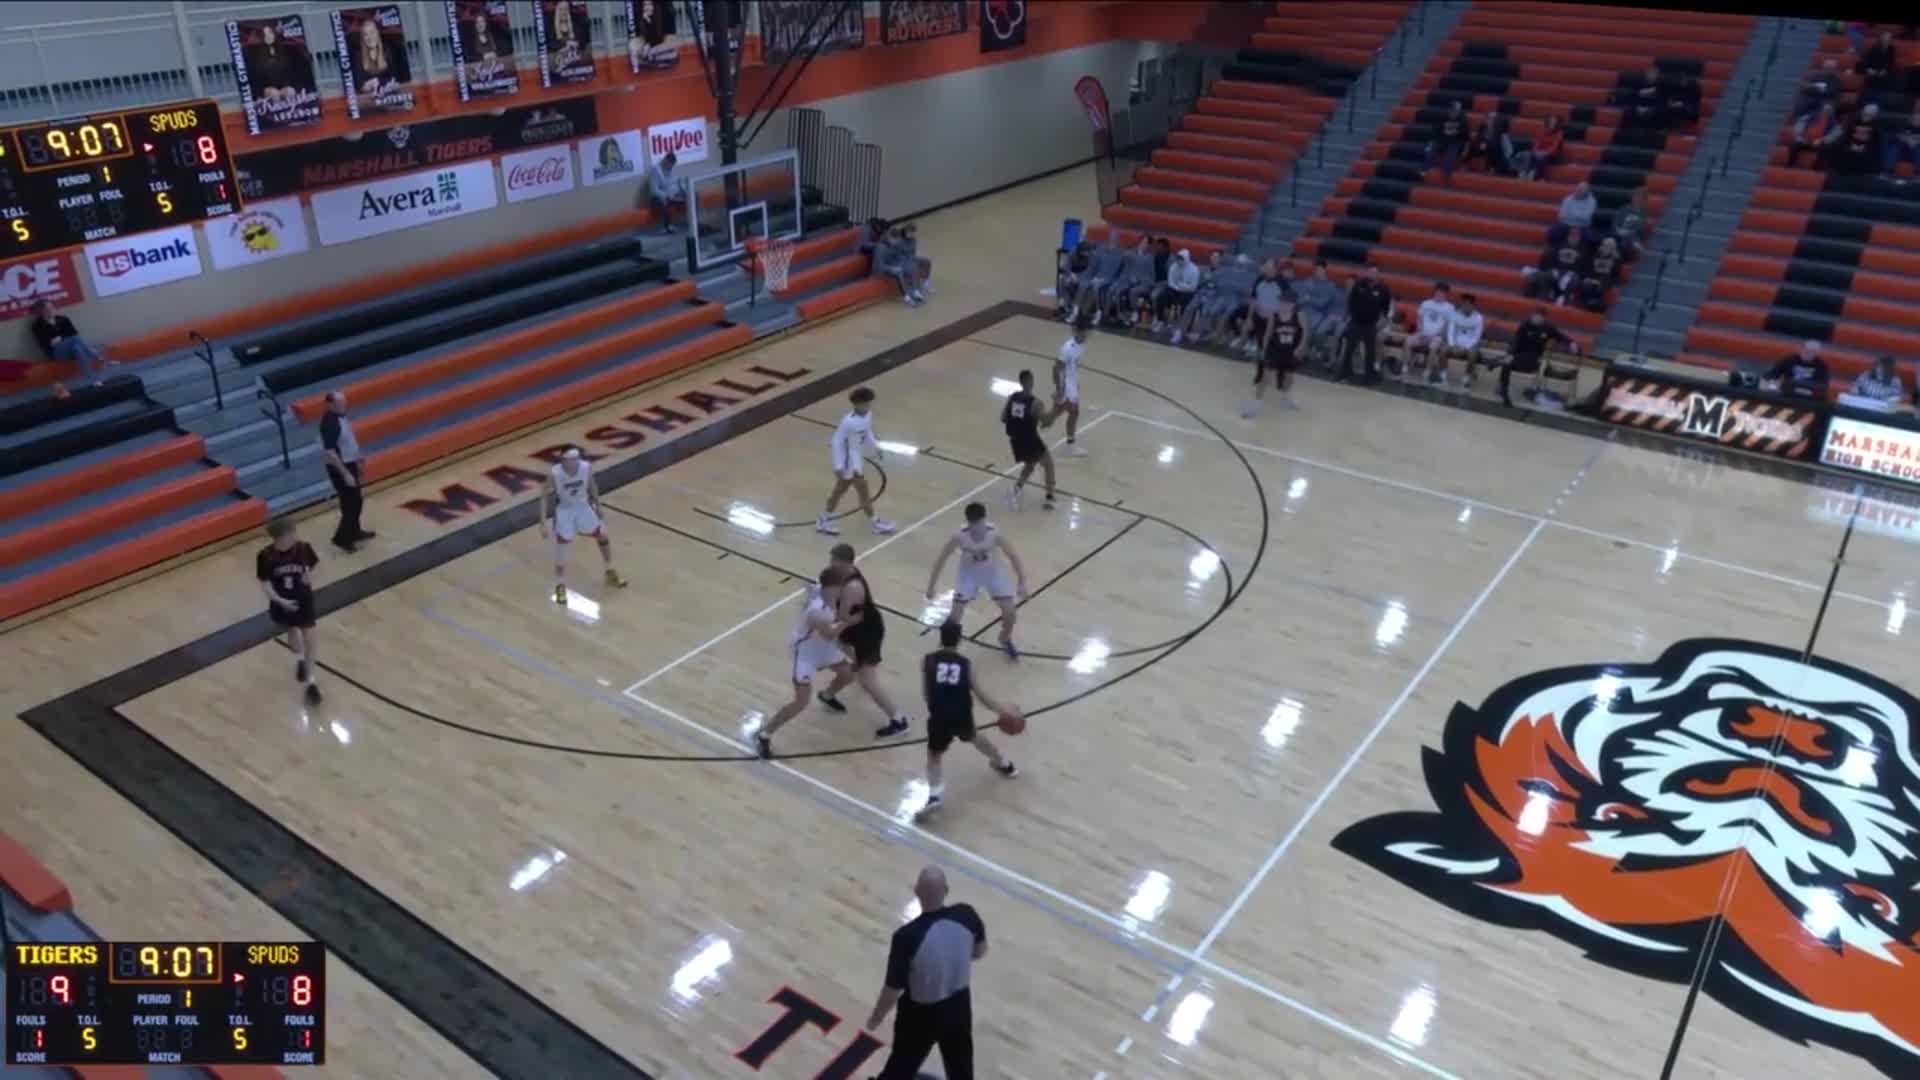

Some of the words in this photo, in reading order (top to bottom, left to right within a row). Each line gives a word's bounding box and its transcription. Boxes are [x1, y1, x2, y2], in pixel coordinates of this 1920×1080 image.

[226, 21, 249, 82] GYMNASTICS
[343, 71, 361, 120] MARSHALL
[150, 109, 198, 133] SPUDS
[239, 85, 261, 136] MARSHALL
[47, 122, 123, 157] 9:07
[197, 135, 217, 165] 8
[302, 152, 418, 187] MARSHALL
[424, 136, 494, 165] TIGERS
[57, 173, 91, 188] PERIOD
[103, 165, 112, 184] 1
[199, 170, 225, 184] FOULS
[59, 193, 95, 209] PLAYER
[99, 189, 124, 201] FOUL
[156, 192, 173, 214] 5
[219, 183, 227, 200] 1
[359, 186, 437, 220] Avera
[206, 203, 233, 217] SCORE
[11, 219, 30, 242] 5
[84, 226, 118, 241] MATCH
[1686, 392, 1729, 437] M
[399, 365, 812, 526] MARSHALL
[1824, 448, 1864, 467] HIGH
[936, 662, 962, 685] 23
